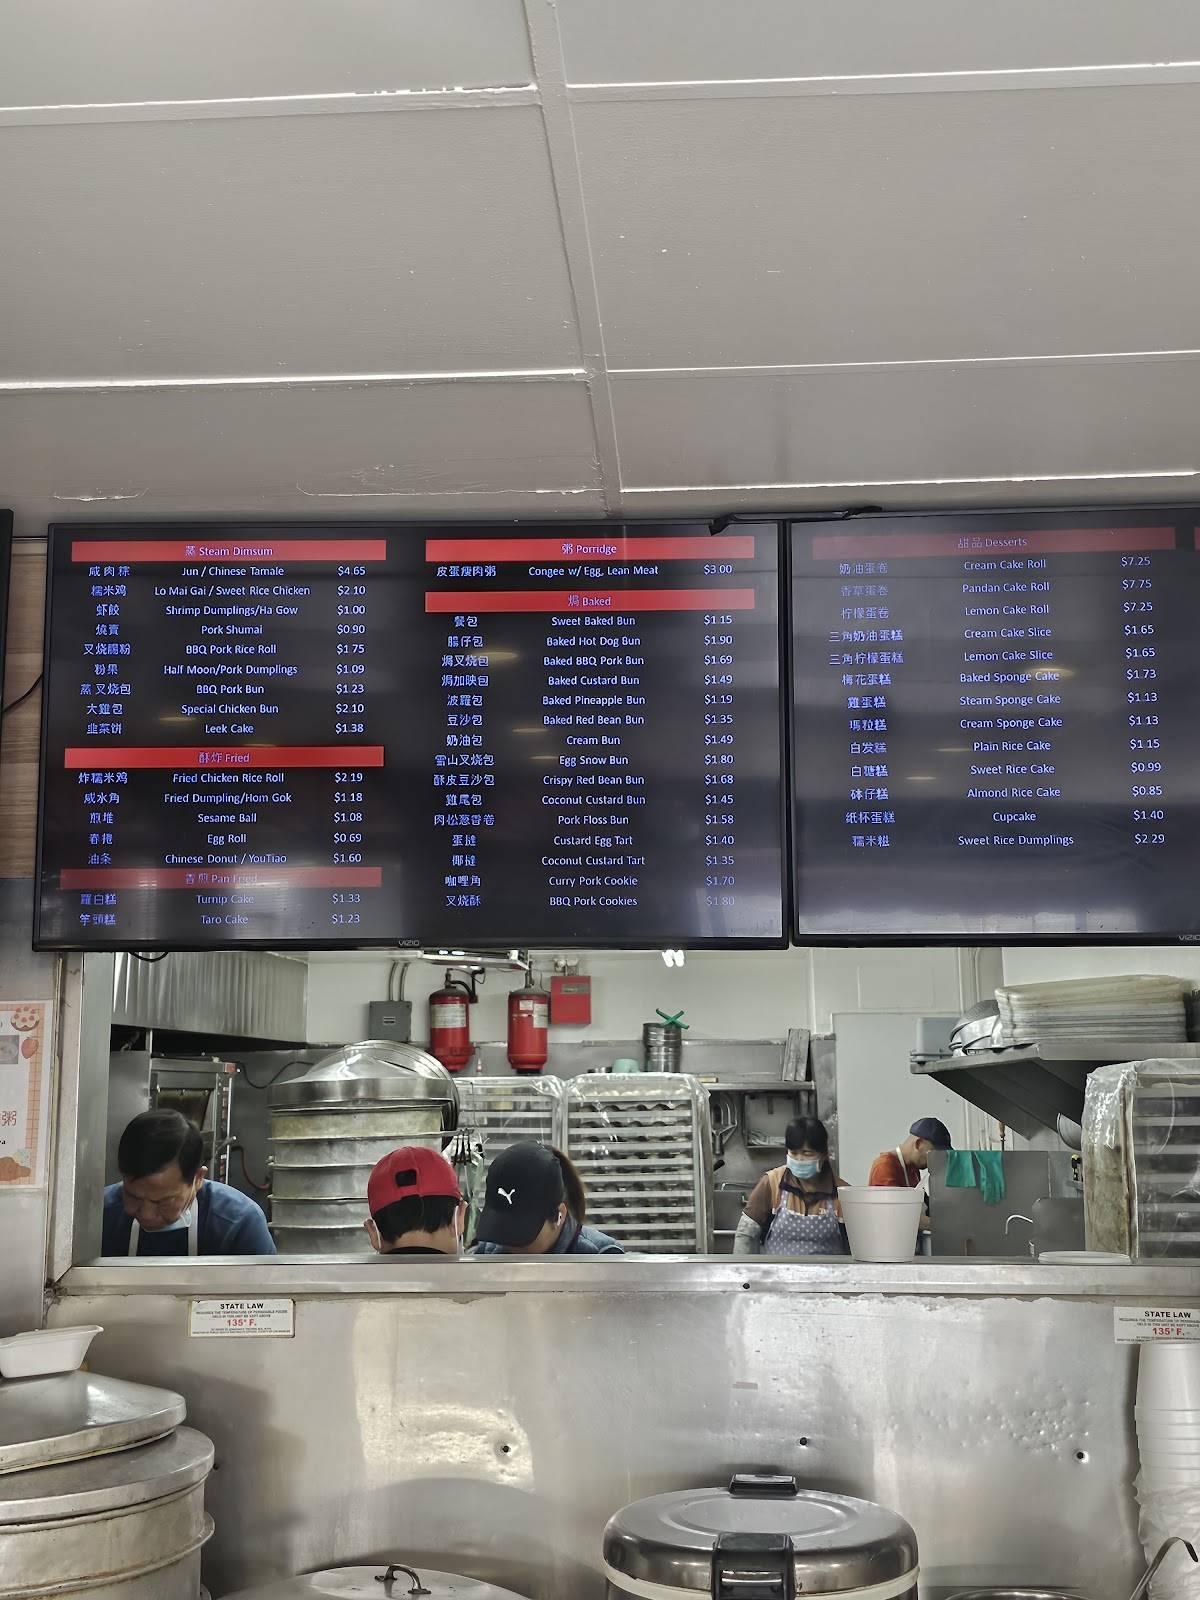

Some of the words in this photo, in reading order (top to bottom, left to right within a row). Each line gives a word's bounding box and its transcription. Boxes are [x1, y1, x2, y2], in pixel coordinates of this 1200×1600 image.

[984, 538, 1028, 547] Desserts
[199, 547, 230, 556] Steam
[233, 546, 273, 556] Dimsum
[576, 544, 617, 555] Porridge
[964, 562, 997, 570] Cream
[999, 560, 1024, 570] Cake
[1027, 559, 1046, 569] Roll
[1120, 555, 1151, 568] $7.25
[962, 583, 1001, 592] Pandan
[1003, 582, 1027, 592] Cake
[1030, 582, 1050, 592] Roll
[581, 596, 611, 606] Baked
[165, 606, 201, 617] Shrimp
[203, 604, 273, 617] Dumplings/Ha
[275, 605, 299, 615] Gow
[336, 604, 366, 616] $1.00
[965, 608, 999, 616] Lemon
[1002, 605, 1027, 614] Cake
[1030, 604, 1049, 614] Roll
[551, 616, 581, 626] Sweet
[584, 616, 614, 626] Baked
[616, 616, 636, 626] Bun
[201, 624, 224, 635] Pork
[226, 624, 263, 634] Shumai
[1124, 624, 1154, 636] $1.65
[546, 636, 576, 646] Baked
[578, 637, 597, 646] Hot
[599, 636, 620, 648] Dog
[621, 636, 641, 646] Bun
[703, 634, 733, 646] $1.90
[186, 644, 208, 655] BBQ
[210, 644, 232, 654] Pork
[235, 644, 255, 654] Rice
[258, 644, 276, 654] Roll
[543, 656, 573, 666] Baked
[576, 656, 597, 666] BBQ
[600, 656, 623, 666] Pork
[625, 656, 644, 665] Bun
[703, 653, 733, 666] $1.69
[964, 652, 999, 662] Lemon
[1002, 650, 1027, 660] Cake
[1029, 650, 1053, 660] Slice
[164, 664, 184, 674] Half
[186, 664, 243, 676] Moon/Pork
[245, 664, 298, 676] Dumplings
[336, 664, 365, 675] $1.09
[548, 676, 577, 686] Baked
[580, 675, 618, 685] Custard
[620, 676, 640, 685] Bun
[703, 674, 733, 686] $1.49
[196, 684, 218, 695] BBQ
[220, 684, 243, 694] Pork
[245, 684, 264, 694] Bun
[335, 683, 365, 695] $1.23
[542, 695, 572, 706] Baked
[574, 695, 623, 707] Pineapple
[626, 695, 646, 705] Bun
[960, 696, 992, 706] Steam
[995, 696, 1033, 706] Sponge
[1036, 694, 1061, 704] Cake
[181, 704, 216, 716] Special
[218, 704, 257, 714] Chicken
[259, 704, 279, 714] Bun
[447, 714, 483, 726] 豆沙包
[543, 715, 573, 725] Baked
[575, 714, 595, 725] Red
[597, 715, 622, 725] Bean
[625, 714, 645, 724] Bun
[960, 719, 993, 728] Cream
[996, 718, 1035, 730] Sponge
[1038, 717, 1063, 727] Cake
[205, 724, 228, 734] Leek
[230, 724, 254, 733] Cake
[335, 722, 364, 734] $1.38
[446, 734, 483, 746] 奶油包
[566, 736, 599, 745] Cream
[601, 736, 621, 745] Bun
[703, 734, 734, 746] $1.49
[973, 741, 999, 752] Plain
[1002, 741, 1024, 750] Rice
[1026, 740, 1051, 750] Cake
[559, 756, 577, 768] Egg
[579, 755, 607, 765] Snow
[609, 755, 629, 764] Bun
[1130, 761, 1162, 774] $0.99
[970, 765, 1002, 775] Sweet
[1006, 764, 1027, 774] Rice
[1030, 764, 1055, 774] Cake
[172, 773, 198, 783] Fried
[200, 772, 239, 783] Chicken
[242, 773, 263, 783] Rice
[265, 772, 284, 783] Roll
[543, 775, 574, 787] Crispy
[576, 775, 595, 785] Red
[598, 775, 622, 785] Bean
[625, 775, 645, 784] Bun
[967, 788, 1008, 798] Almond
[1011, 788, 1033, 797] Rice
[1036, 787, 1061, 797] Cake
[1131, 784, 1163, 797] $0.85
[164, 793, 190, 803] Fried
[192, 792, 269, 805] Dumpling/Hom
[271, 792, 292, 802] Gok
[197, 813, 236, 823] Sesame
[239, 812, 257, 823] Ball
[333, 812, 363, 824] $1.08
[558, 815, 581, 825] Pork
[583, 815, 608, 825] Floss
[610, 815, 629, 824] Bun
[992, 811, 1037, 824] Cupcake
[1133, 809, 1164, 822] $1.40
[207, 834, 225, 846] Egg
[228, 834, 246, 843] Roll
[553, 836, 591, 846] Custard
[594, 836, 613, 848] Egg
[614, 836, 633, 845] Tart
[704, 834, 735, 846] $1.40
[958, 836, 990, 846] Sweet
[993, 836, 1015, 845] Rice
[1018, 834, 1074, 847] Dumplings
[333, 852, 362, 864] $1.60
[548, 876, 576, 888] Curry
[579, 876, 602, 886] Pork
[604, 876, 638, 886] Cookie
[549, 896, 571, 907] BBQ
[573, 896, 597, 906] Pork
[599, 896, 638, 906] Cookies
[1144, 1310, 1171, 1318] STATE
[1176, 1328, 1185, 1336] F.
